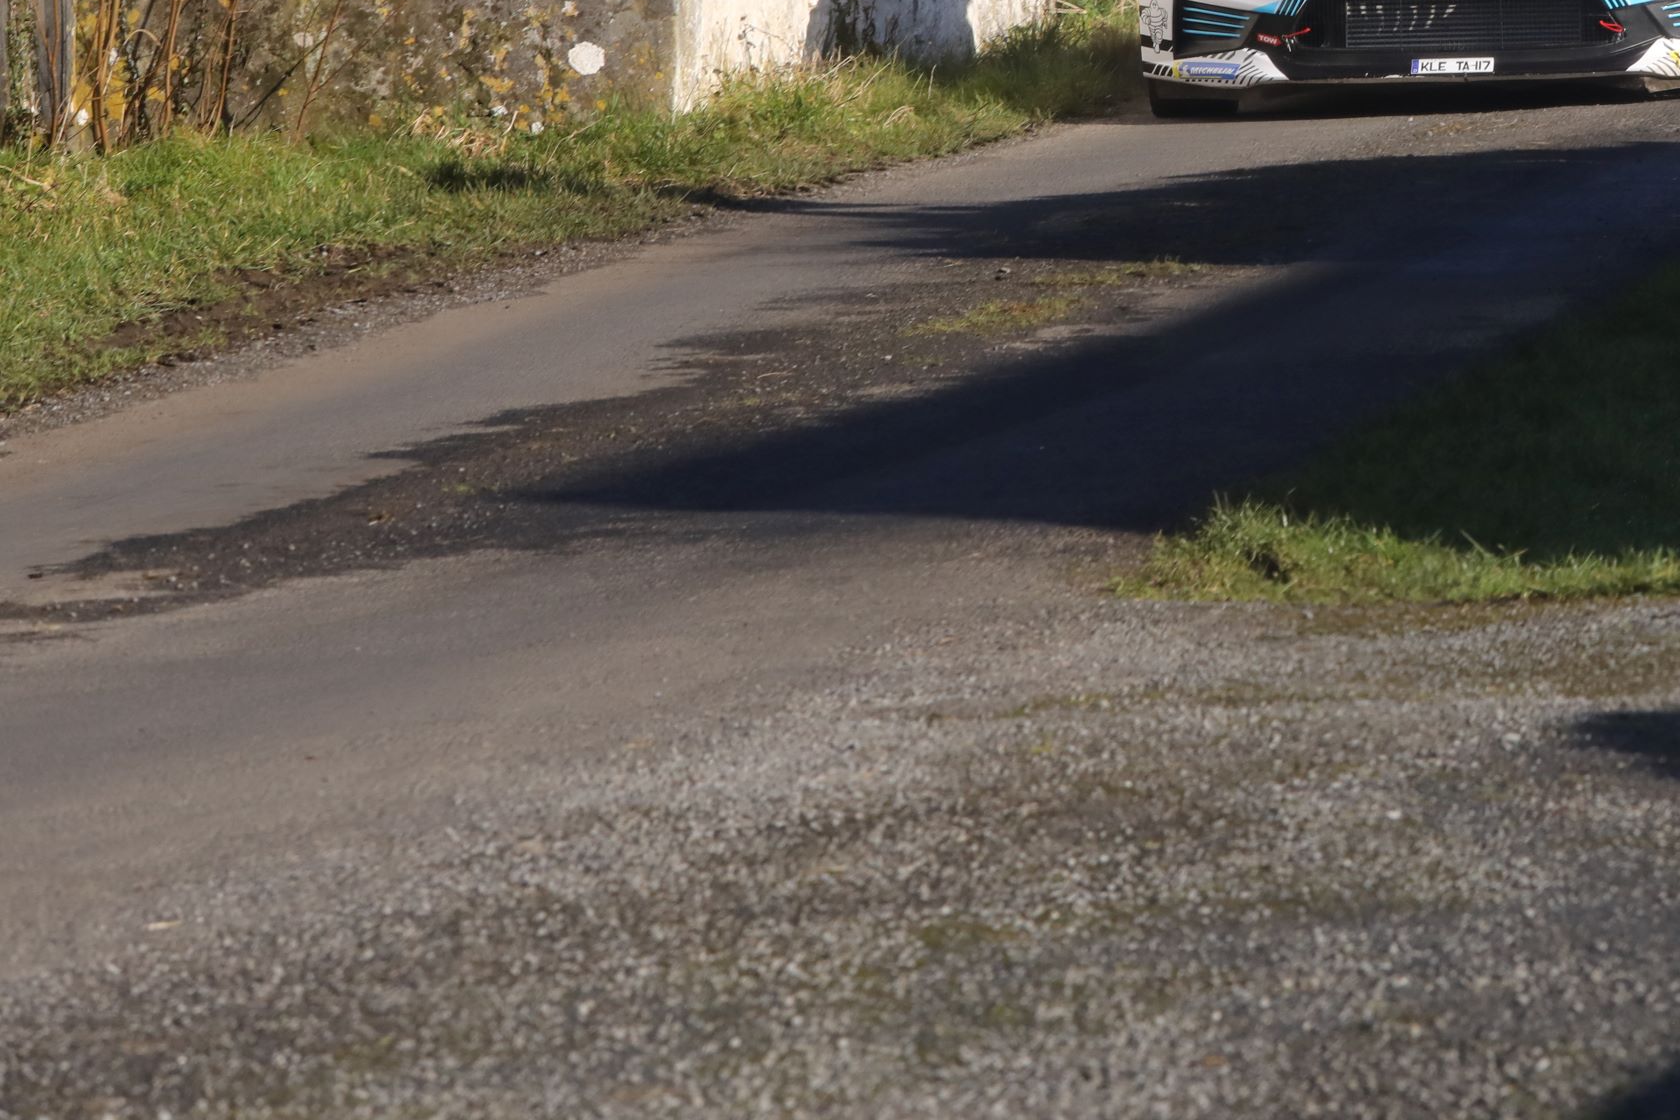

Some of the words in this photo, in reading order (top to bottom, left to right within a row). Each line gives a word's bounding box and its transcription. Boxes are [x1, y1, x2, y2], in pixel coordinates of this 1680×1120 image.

[1257, 34, 1278, 44] TOW
[1189, 65, 1235, 76] MICHELIN
[1420, 61, 1447, 72] KLE
